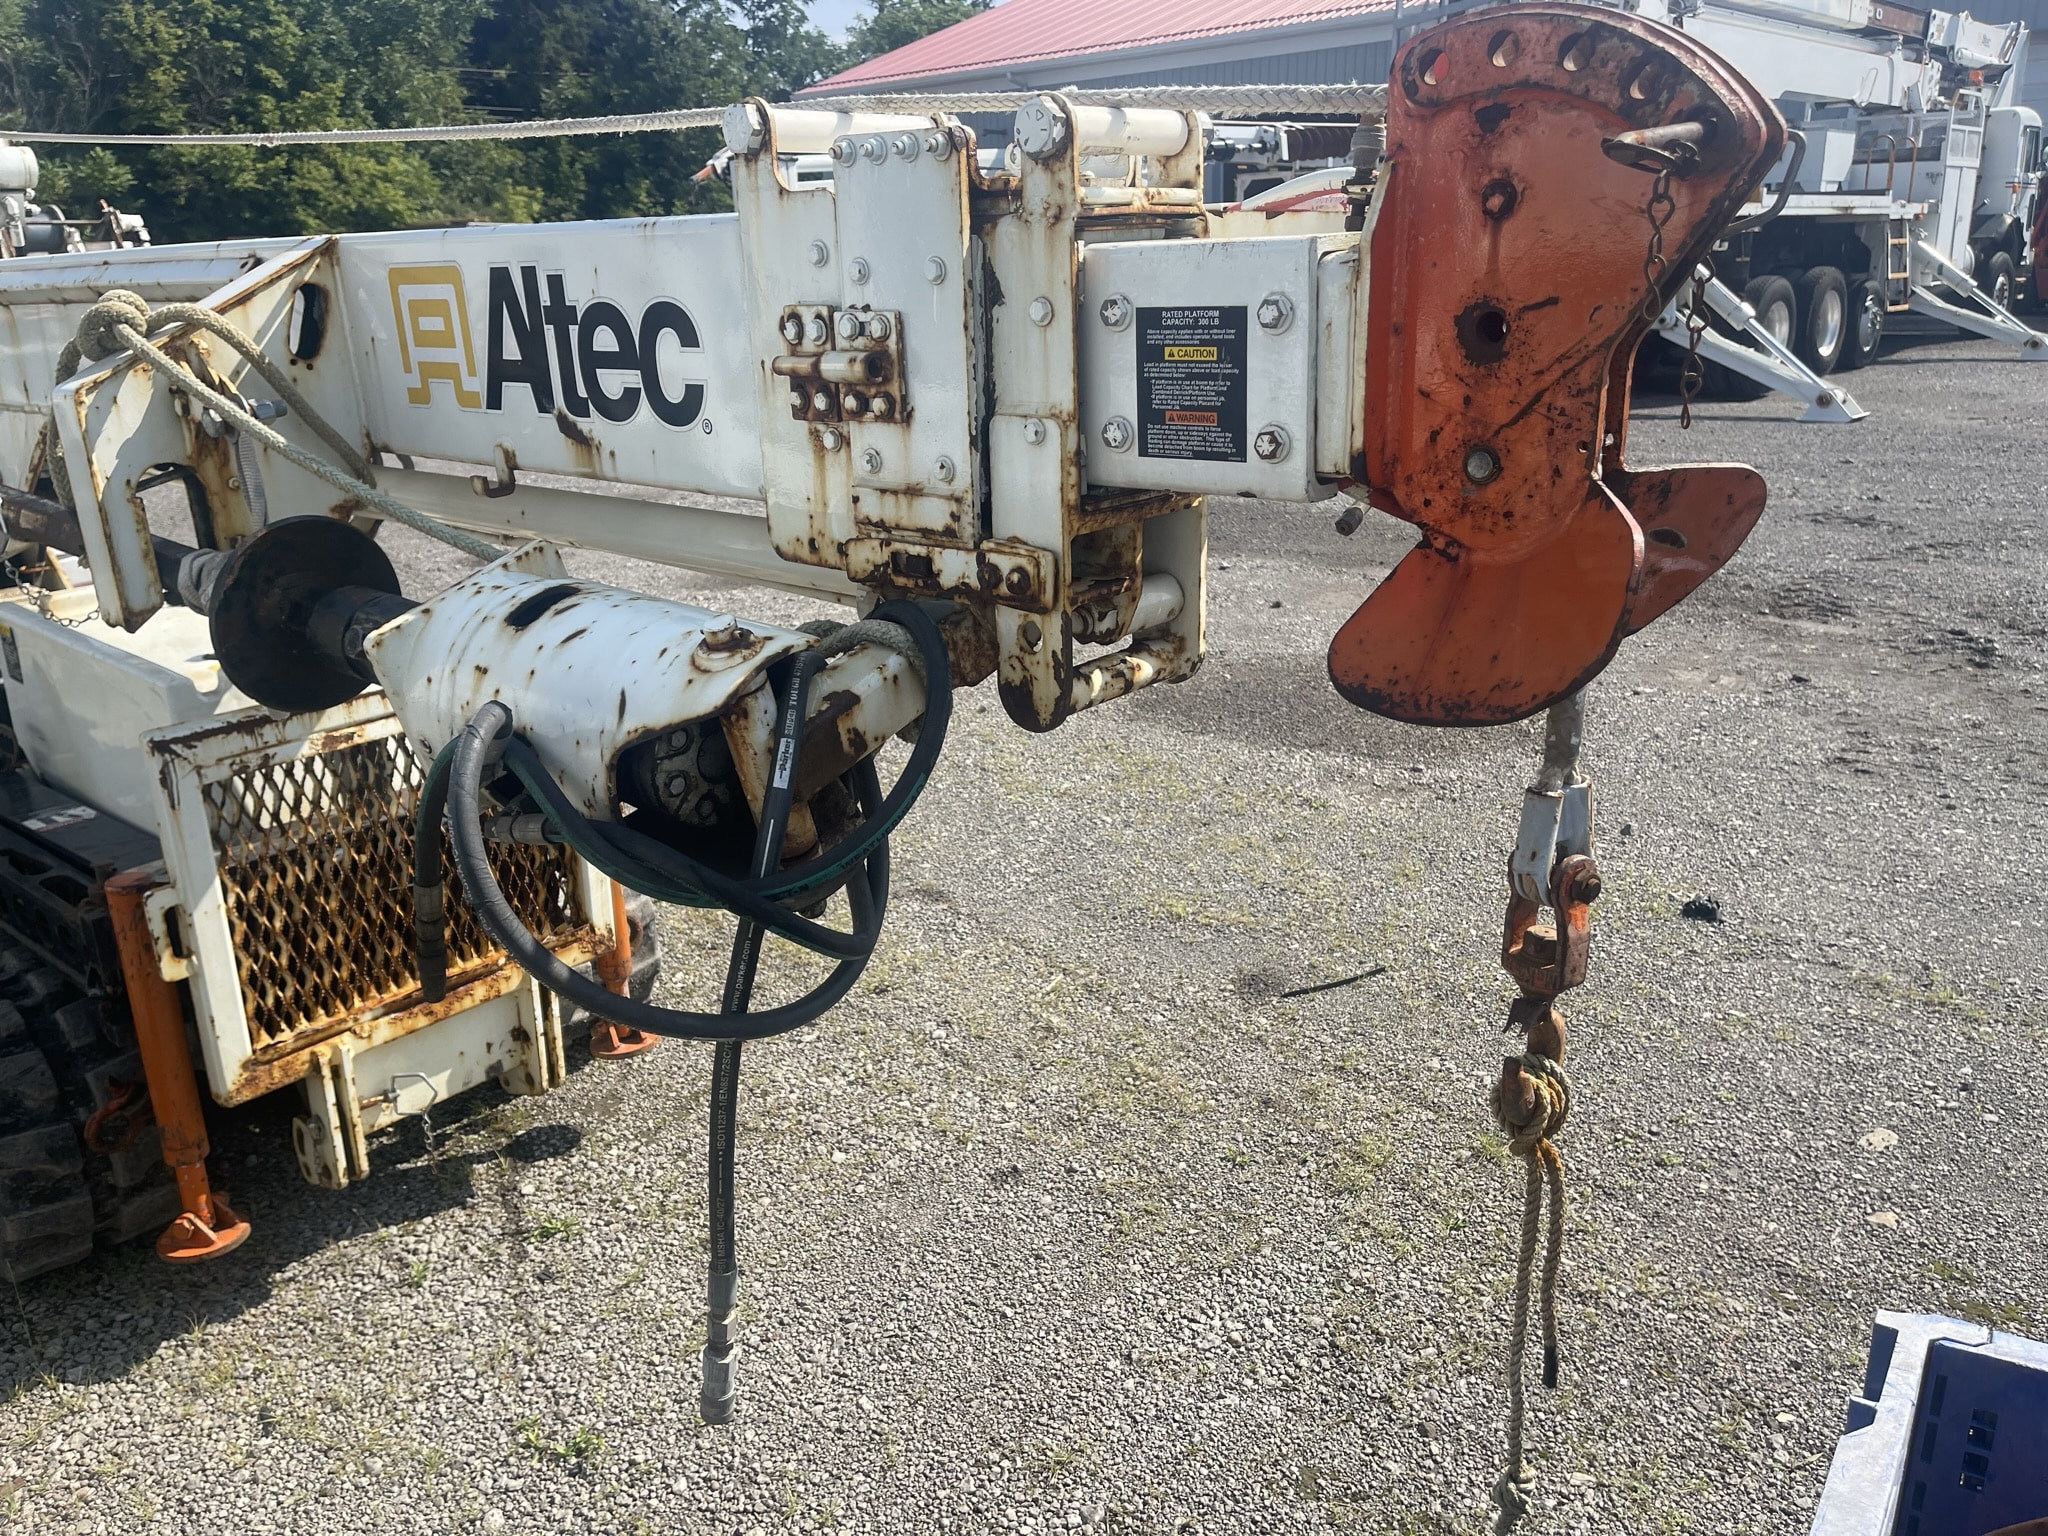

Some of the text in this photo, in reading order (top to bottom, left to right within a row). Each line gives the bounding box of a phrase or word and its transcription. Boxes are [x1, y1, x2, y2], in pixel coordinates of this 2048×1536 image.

[486, 265, 704, 428] Altec
[1177, 349, 1214, 358] CAUTION
[1177, 414, 1215, 423] WARNING
[732, 940, 752, 1011] www.parker.com
[718, 1232, 726, 1256] MSHA
